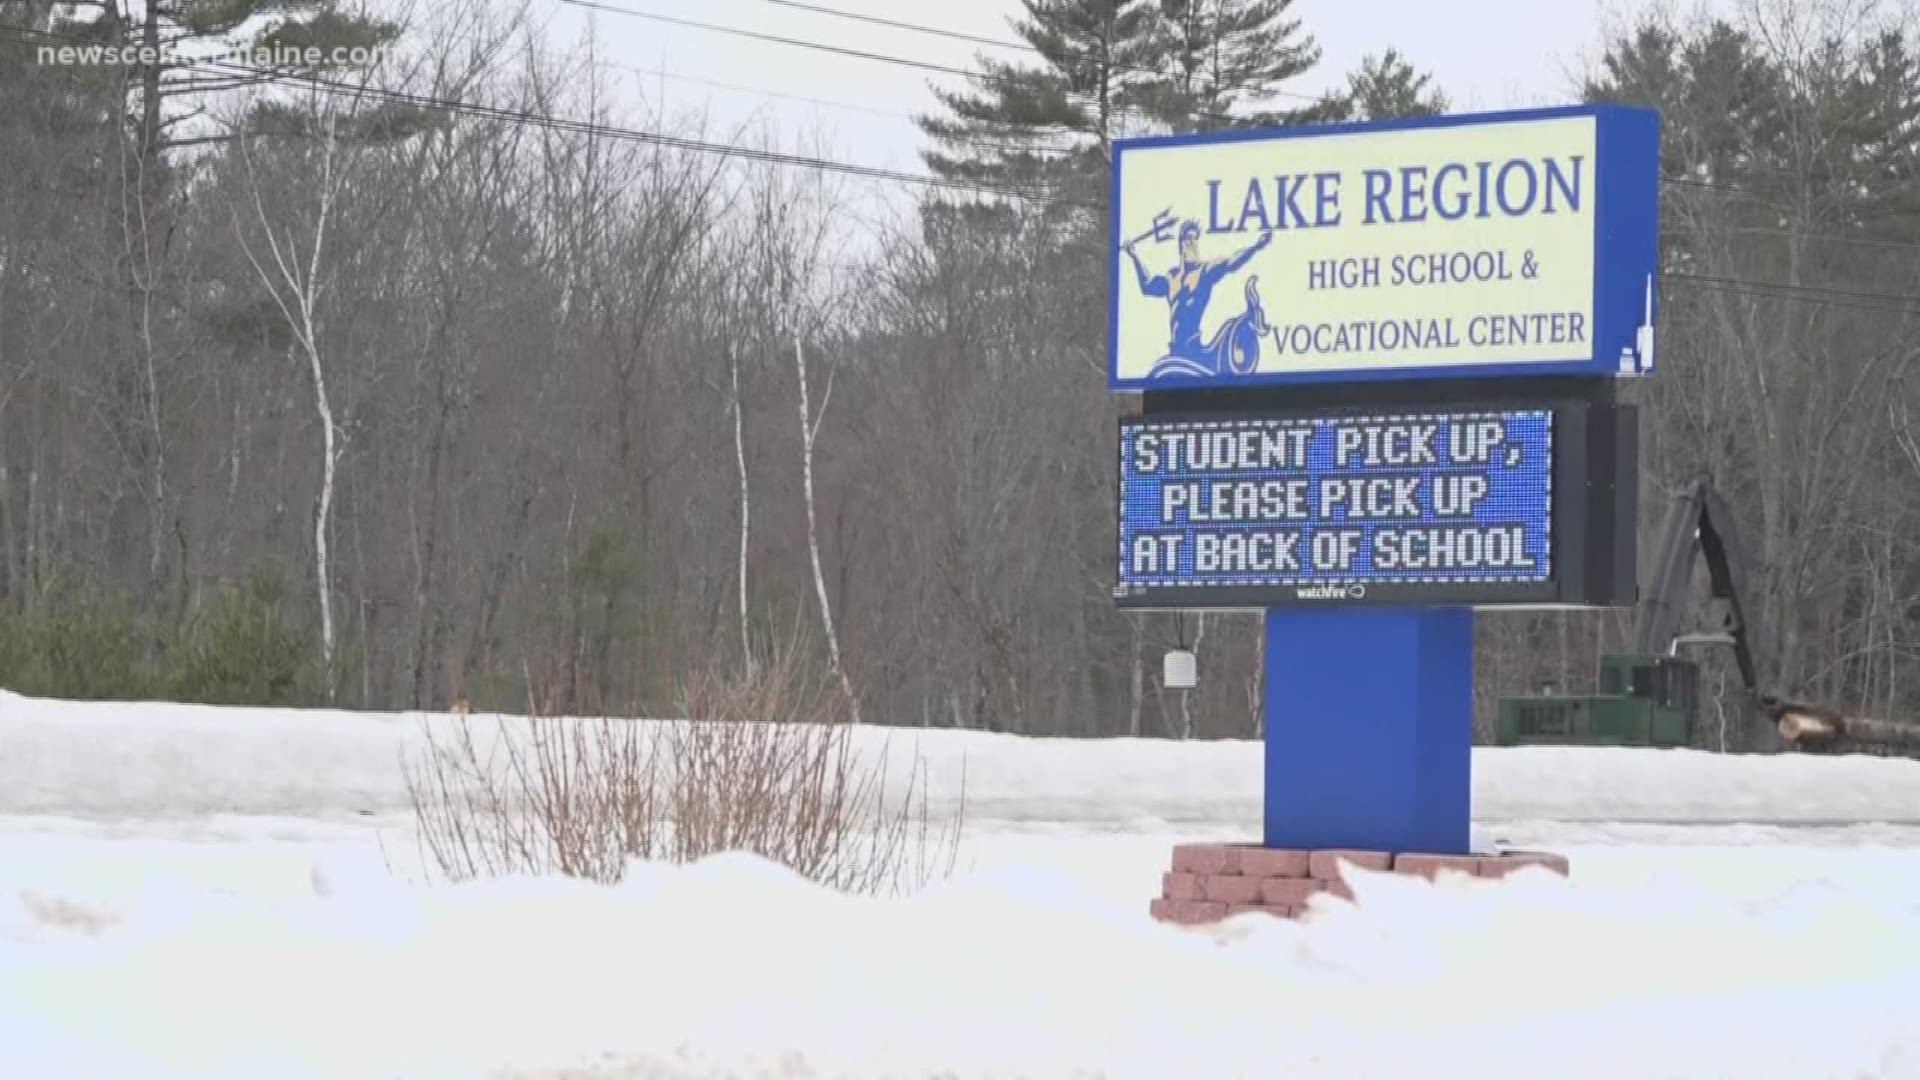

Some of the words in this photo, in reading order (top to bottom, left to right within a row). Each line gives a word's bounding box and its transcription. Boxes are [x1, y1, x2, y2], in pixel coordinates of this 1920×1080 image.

[1205, 171, 1342, 235] LAKE
[1362, 155, 1585, 225] REGION
[1307, 257, 1380, 290] HIGH
[1391, 252, 1512, 286] SCHOOL
[1521, 250, 1540, 278] &
[1272, 317, 1459, 355] VOCATIONAL
[1468, 312, 1586, 346] CENTER
[1135, 430, 1312, 472] STUDENT
[1336, 424, 1437, 466] PICK
[1450, 421, 1523, 466] UP,
[1162, 480, 1308, 522] PLEASE
[1320, 477, 1420, 518] PICK
[1433, 475, 1488, 514] UP
[1133, 534, 1183, 573] AT
[1196, 532, 1300, 571] BACK
[1313, 530, 1363, 569] OF
[1374, 527, 1535, 568] SCHOOL
[1297, 585, 1346, 600] watchfire
